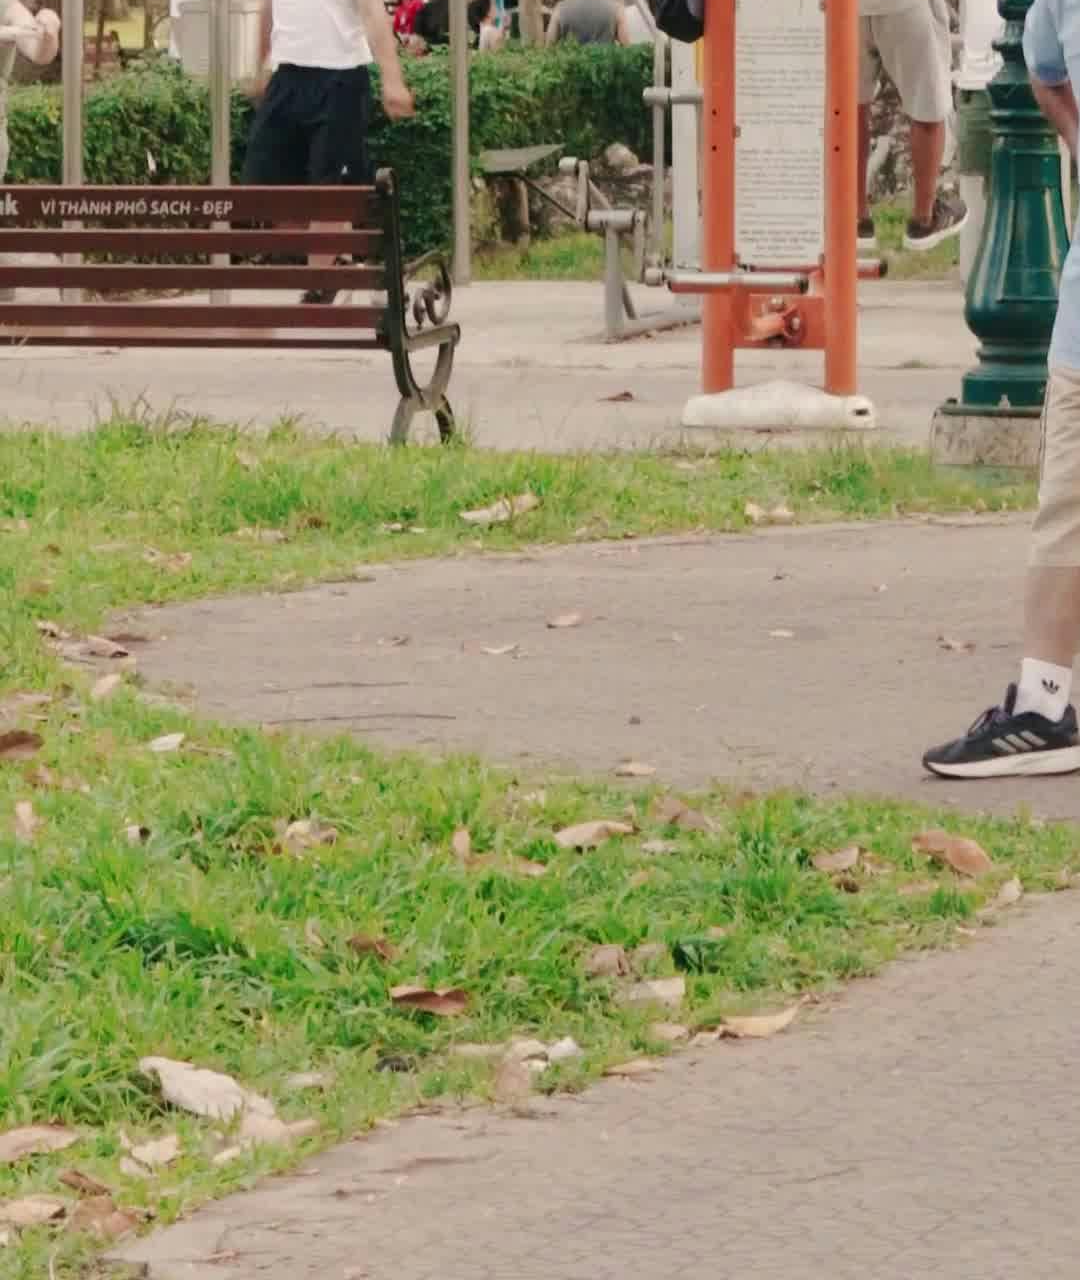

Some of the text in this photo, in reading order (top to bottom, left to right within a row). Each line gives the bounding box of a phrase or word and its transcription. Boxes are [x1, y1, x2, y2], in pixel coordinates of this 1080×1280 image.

[59, 197, 111, 215] THÀNH
[114, 197, 147, 215] PHỐ
[150, 200, 191, 219] SẠCH
[202, 200, 233, 219] ĐẸP
